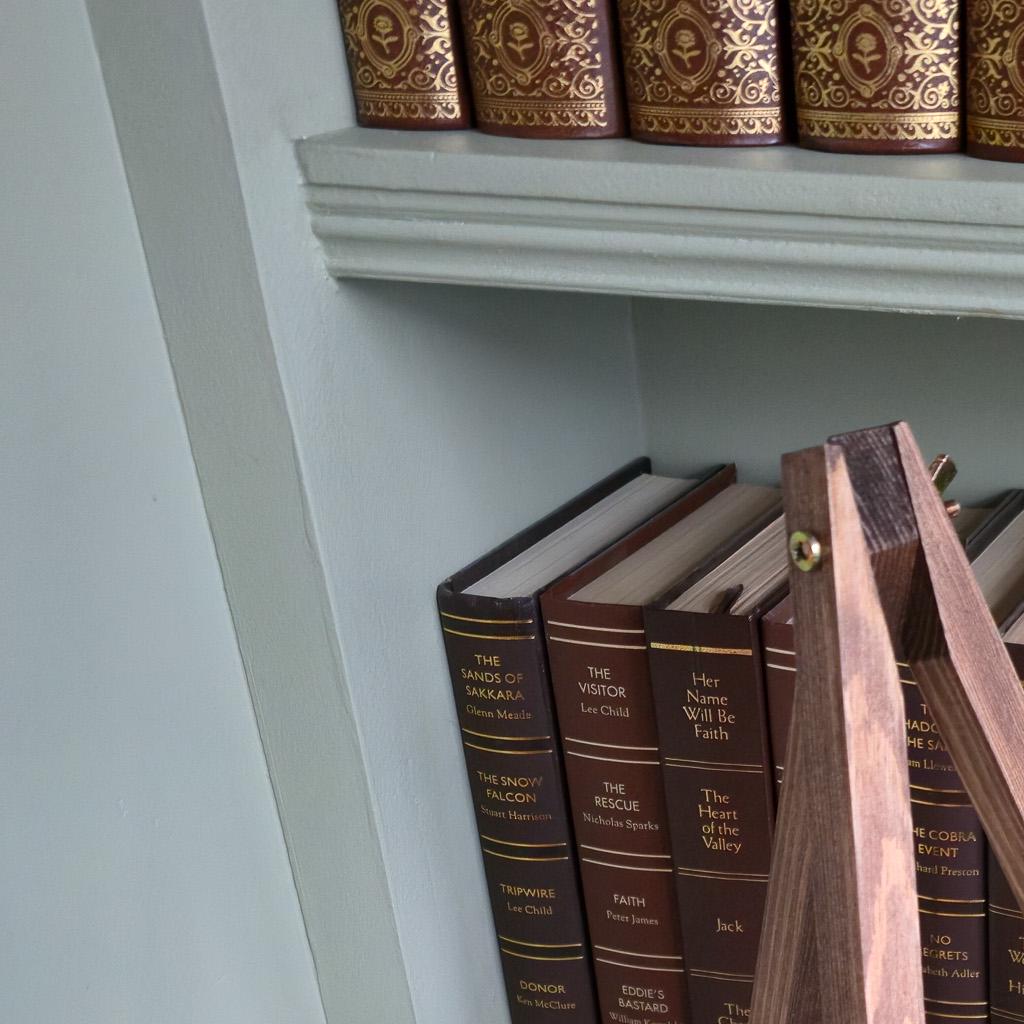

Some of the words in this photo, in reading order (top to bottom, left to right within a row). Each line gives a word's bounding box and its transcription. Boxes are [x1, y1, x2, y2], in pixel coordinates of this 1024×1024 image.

[475, 654, 501, 667] THE
[461, 668, 501, 684] SANDS
[504, 672, 524, 684] OF
[588, 666, 611, 680] THE
[692, 673, 720, 688] Her
[466, 687, 525, 701] SAKKARA
[578, 682, 627, 698] VISITOR
[687, 690, 728, 705] Name
[466, 705, 494, 720] Glenn
[581, 703, 598, 715] Lee
[600, 705, 630, 717] Child
[683, 706, 713, 723] Will
[718, 710, 736, 724] Be
[695, 724, 729, 741] Faith
[477, 771, 499, 786] THE
[501, 775, 543, 788] SNOW
[603, 782, 626, 794] THE
[486, 789, 537, 803] FALCON
[700, 789, 730, 804] The
[594, 796, 640, 812] RESCUE
[699, 805, 738, 820] Heart
[583, 813, 624, 828] Nicholas
[625, 818, 659, 831] Sparks
[702, 821, 716, 835] of
[718, 822, 740, 836] the
[928, 830, 976, 842] COBRA
[702, 835, 742, 854] Valley
[918, 844, 959, 858] EVENT
[501, 884, 555, 899] TRIPWIRE
[613, 894, 646, 908] FAITH
[507, 903, 523, 915] Lee
[525, 903, 553, 916] Child
[606, 910, 629, 923] Peter
[631, 914, 659, 926] James
[716, 919, 744, 933] Jack
[930, 935, 951, 946] NO
[951, 969, 980, 979] Adler
[520, 980, 566, 993] DONOR
[622, 985, 665, 1000] EDDIE'S
[618, 998, 669, 1013] BASTARD
[723, 1003, 750, 1017] The
